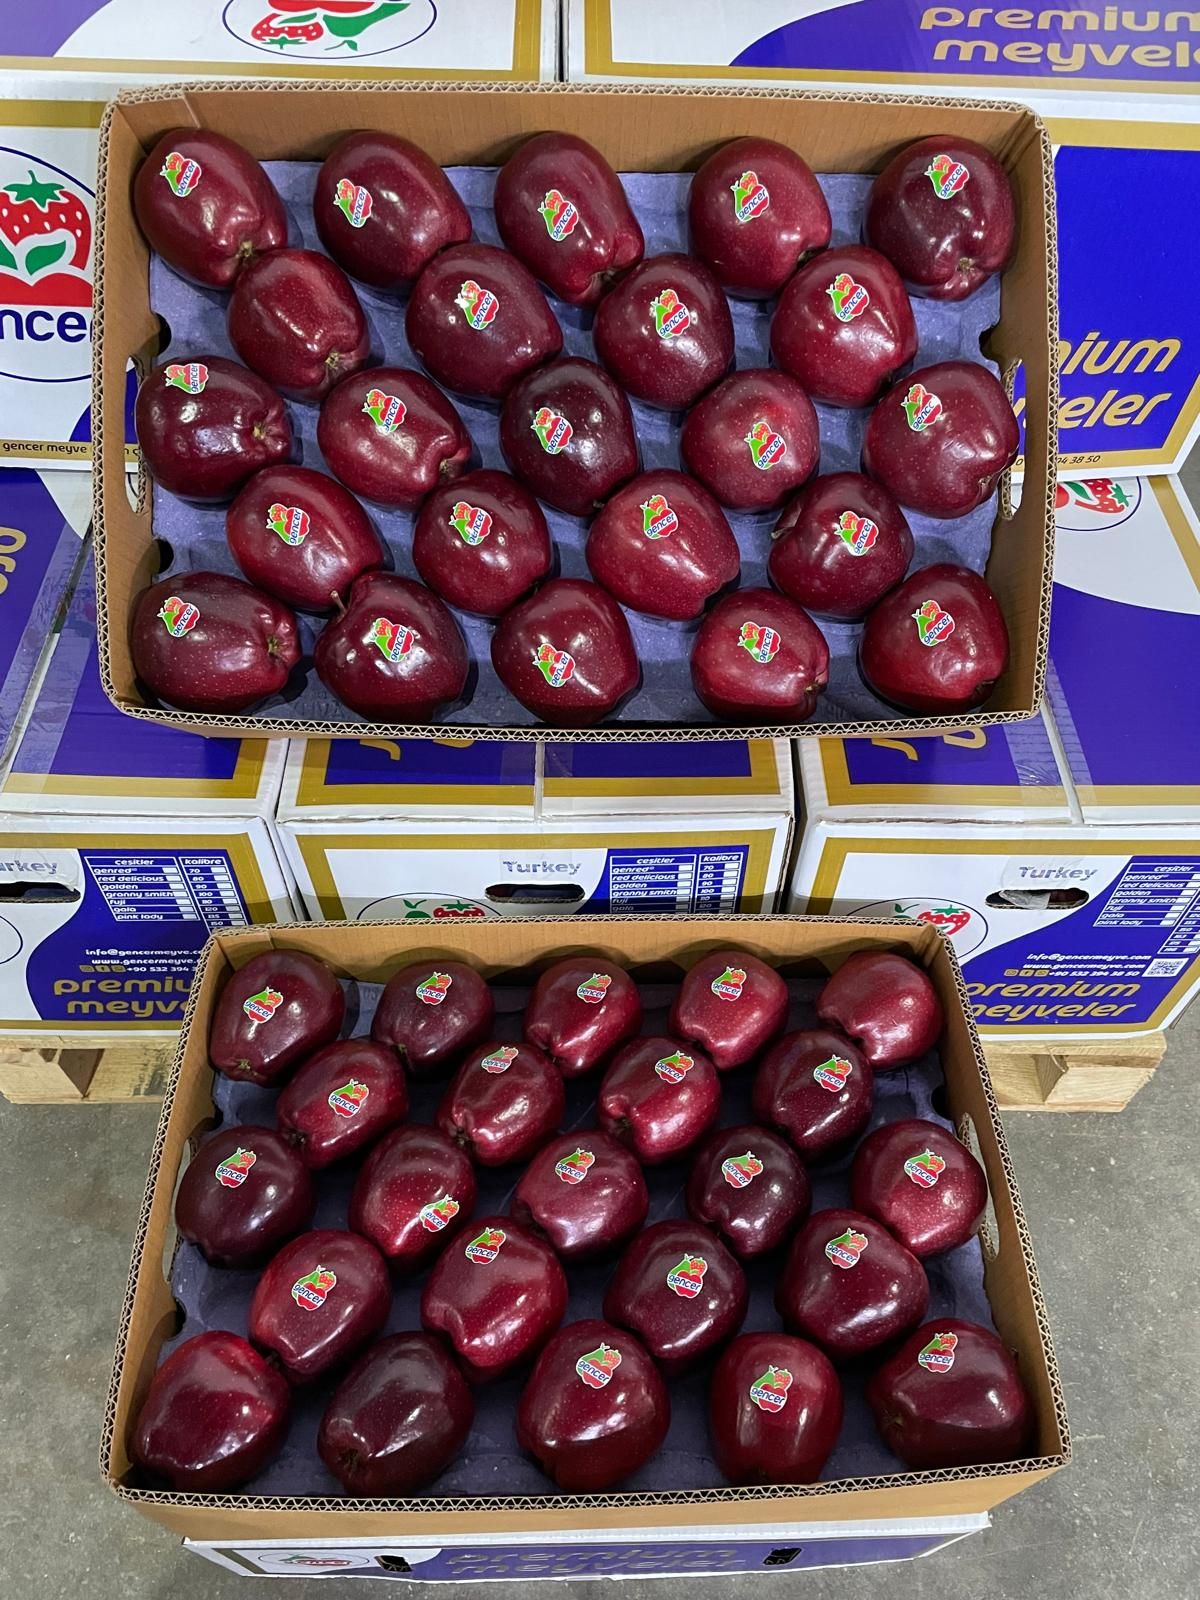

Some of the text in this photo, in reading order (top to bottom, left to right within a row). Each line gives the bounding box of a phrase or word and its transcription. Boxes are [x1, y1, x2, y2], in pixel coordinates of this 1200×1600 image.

[933, 39, 1200, 73] meyvel
[178, 163, 195, 195] gencer
[940, 167, 964, 197] gencer
[353, 190, 366, 225] gencer
[739, 189, 767, 219] gencer
[552, 206, 574, 239] gencer
[473, 296, 493, 328] gencer
[839, 288, 865, 319] gencer
[0, 309, 91, 342] nce
[659, 308, 686, 335] gencer
[1058, 331, 1182, 375] ium
[191, 364, 199, 392] gencer
[1058, 389, 1172, 429] eler
[547, 418, 567, 451] gencer
[3, 442, 87, 454] gencer meyve
[757, 436, 782, 468] gencer
[1069, 456, 1084, 464] 38
[1085, 455, 1101, 463] 50
[290, 510, 301, 544] gencer
[469, 511, 485, 544] gencer
[646, 512, 675, 536] gencer
[854, 521, 872, 554] gencer
[173, 606, 194, 636] gencer
[924, 615, 950, 644] gencer
[390, 628, 406, 660] gencer
[759, 629, 773, 662] gencer
[551, 653, 569, 685] gencer
[502, 860, 582, 875] Turkey
[1019, 866, 1098, 881] Turkey
[86, 949, 202, 958] info@gencermeyve.co
[91, 958, 198, 966] www.gencermeyve.
[1027, 953, 1152, 961] info@gencermeyve.com
[53, 976, 194, 995] premiu
[418, 987, 445, 999] gencer
[579, 987, 604, 998] gencer
[712, 983, 740, 996] gencer
[245, 1000, 271, 1018] gencer
[483, 1059, 508, 1068] gencer
[657, 1062, 683, 1079] gencer
[815, 1070, 843, 1086] gencer
[330, 1094, 358, 1112] gencer
[218, 1166, 245, 1180] gencer
[557, 1163, 583, 1178] gencer
[724, 1161, 748, 1184] gencer
[905, 1161, 935, 1183] gencer
[424, 1211, 445, 1228] encer
[467, 1246, 497, 1257] gencer
[827, 1244, 857, 1262] gencer
[669, 1274, 700, 1290] gencer
[294, 1284, 323, 1304] gencer
[919, 1353, 952, 1364] gencer
[578, 1360, 609, 1381] gencer
[751, 1387, 785, 1403] gencer
